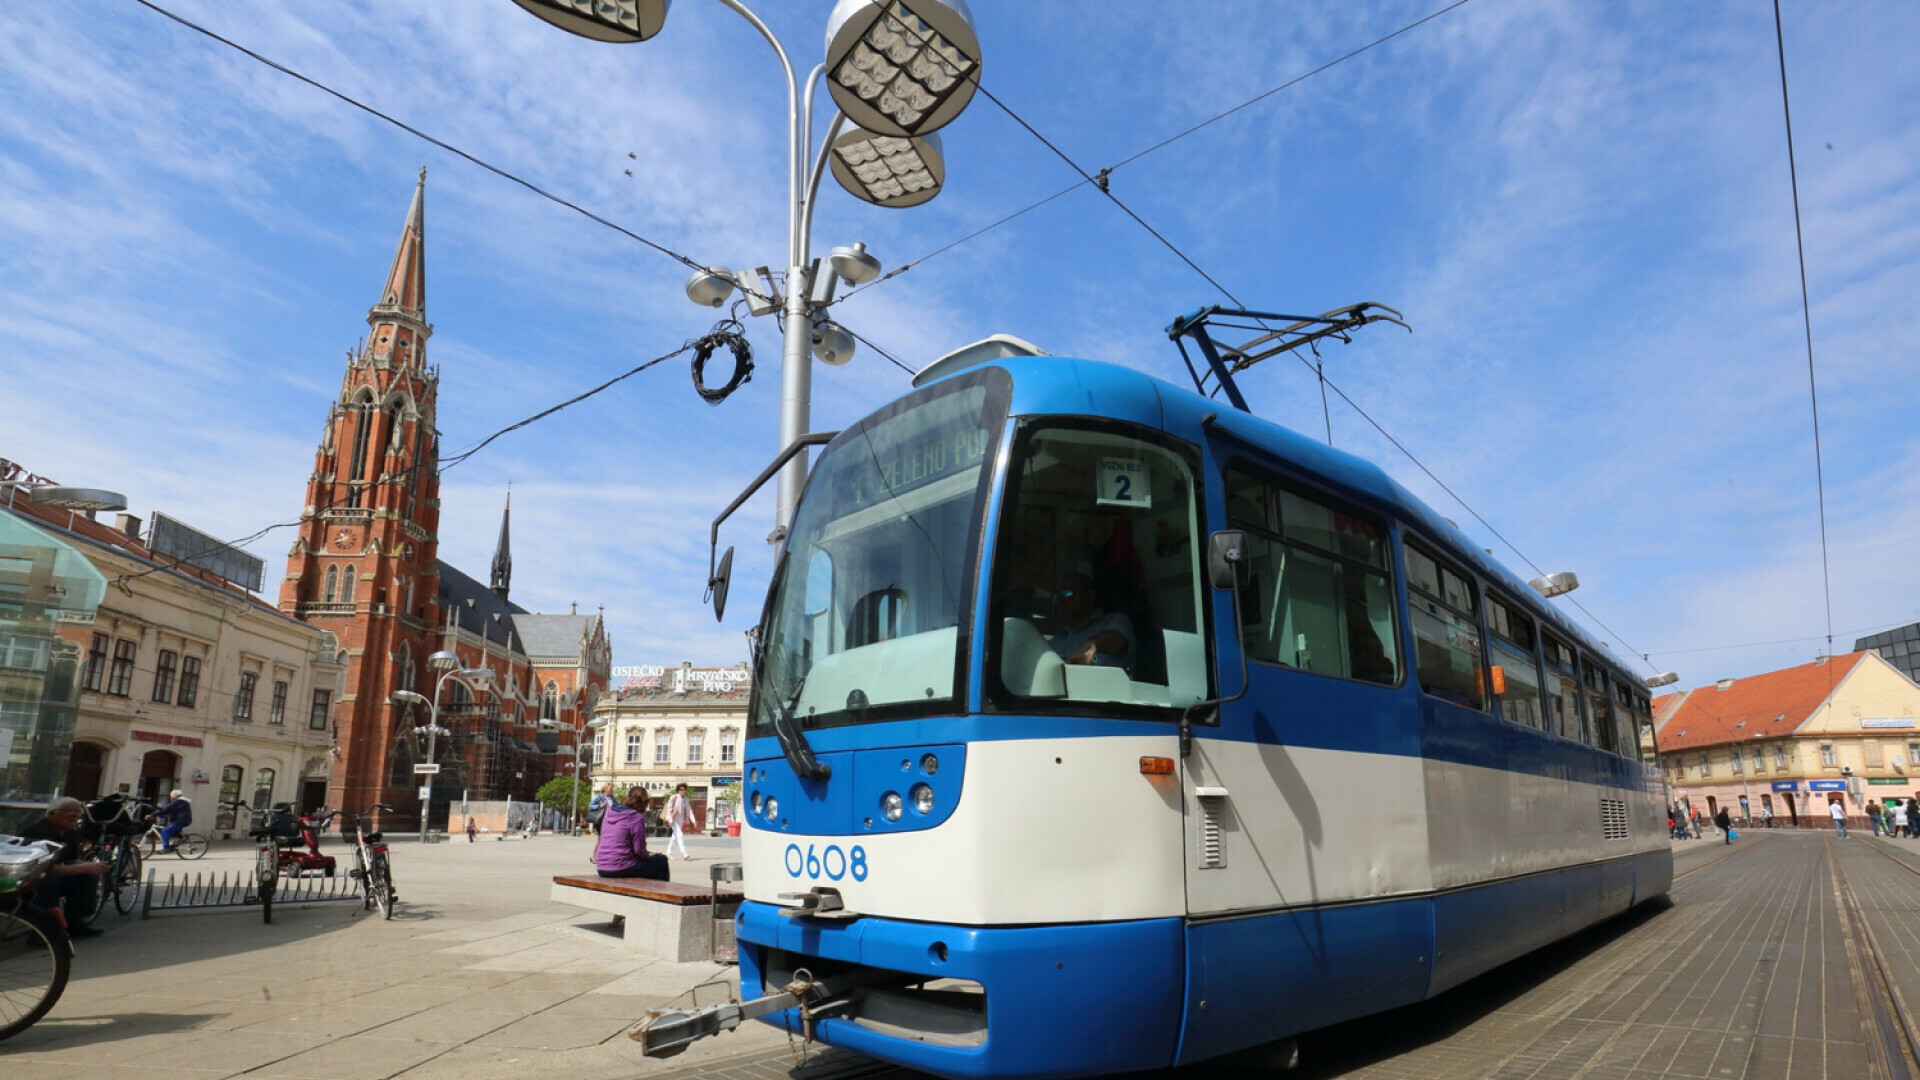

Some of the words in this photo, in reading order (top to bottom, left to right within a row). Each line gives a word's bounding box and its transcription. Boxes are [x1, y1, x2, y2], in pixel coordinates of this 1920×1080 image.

[1115, 475, 1132, 501] 2
[612, 664, 665, 679] OSJEČKO
[686, 668, 749, 682] HRVATSKO
[703, 681, 732, 692] PIVO
[785, 843, 868, 882] 0608
